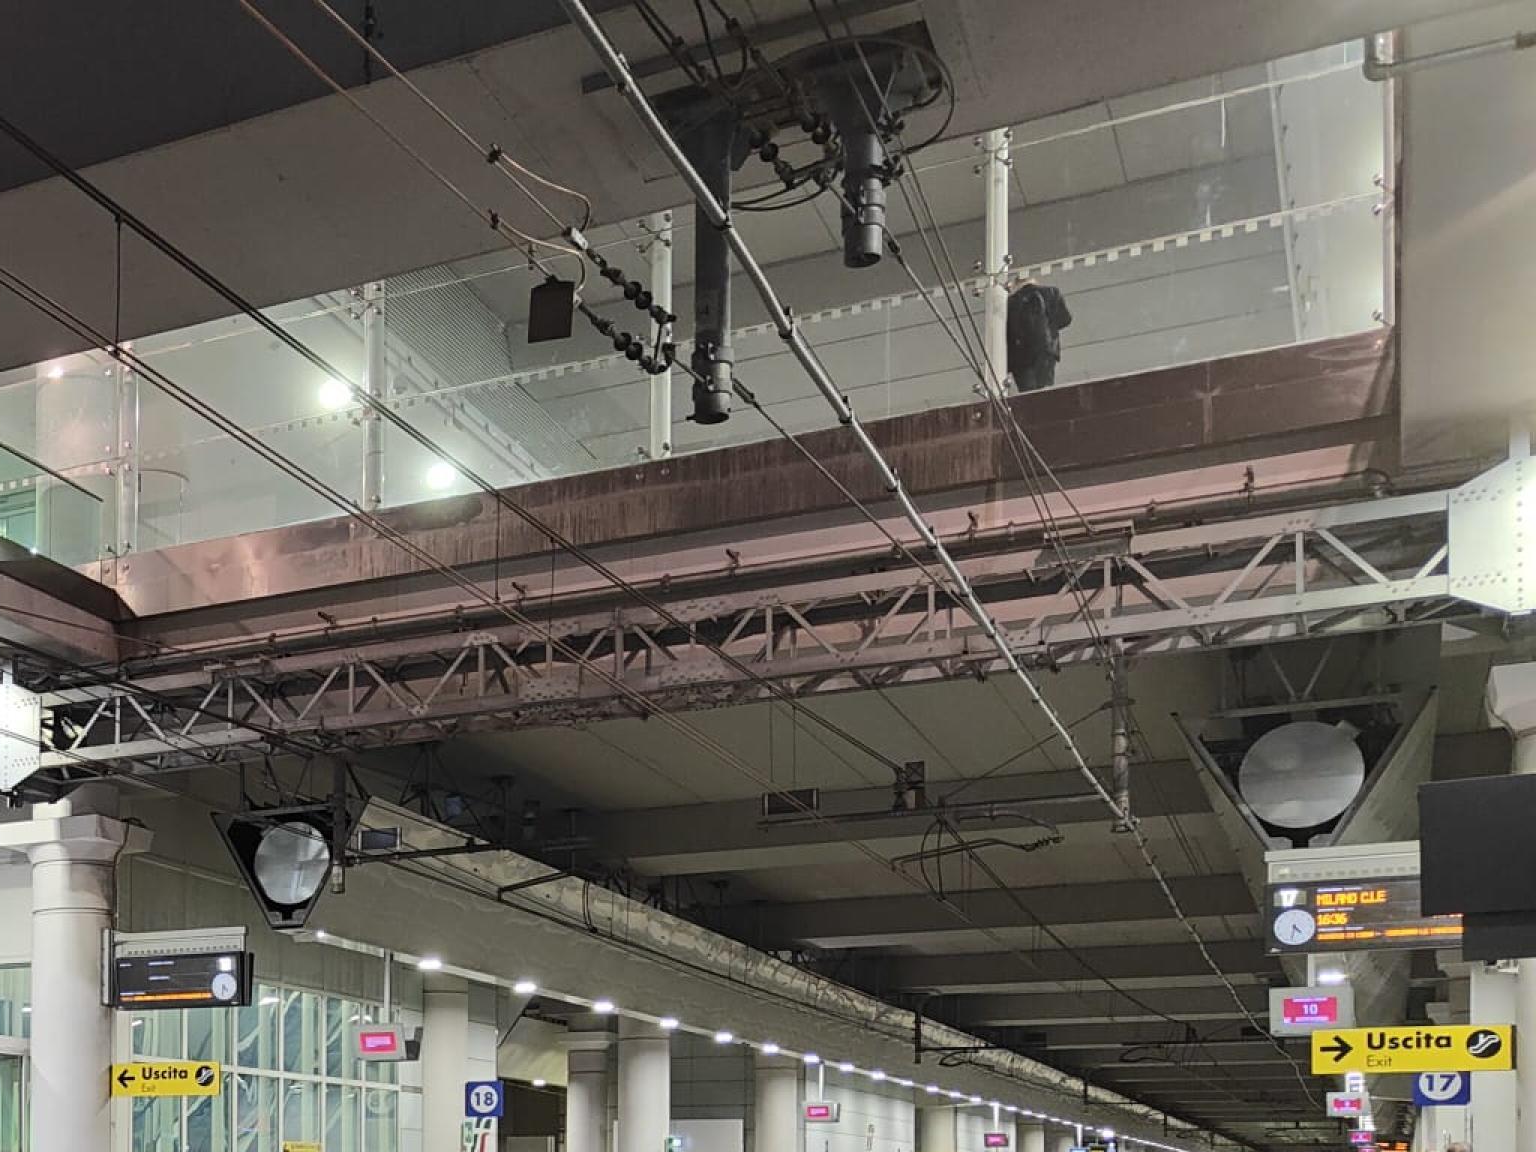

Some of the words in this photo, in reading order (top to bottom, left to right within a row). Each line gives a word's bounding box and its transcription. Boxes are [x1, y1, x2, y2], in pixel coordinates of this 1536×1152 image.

[1302, 1004, 1319, 1015] 10
[1366, 1031, 1453, 1051] Uscita
[1366, 1056, 1393, 1068] Exit
[141, 1066, 189, 1081] Uscita
[1425, 1074, 1457, 1093] 17
[473, 1091, 494, 1107] 18
